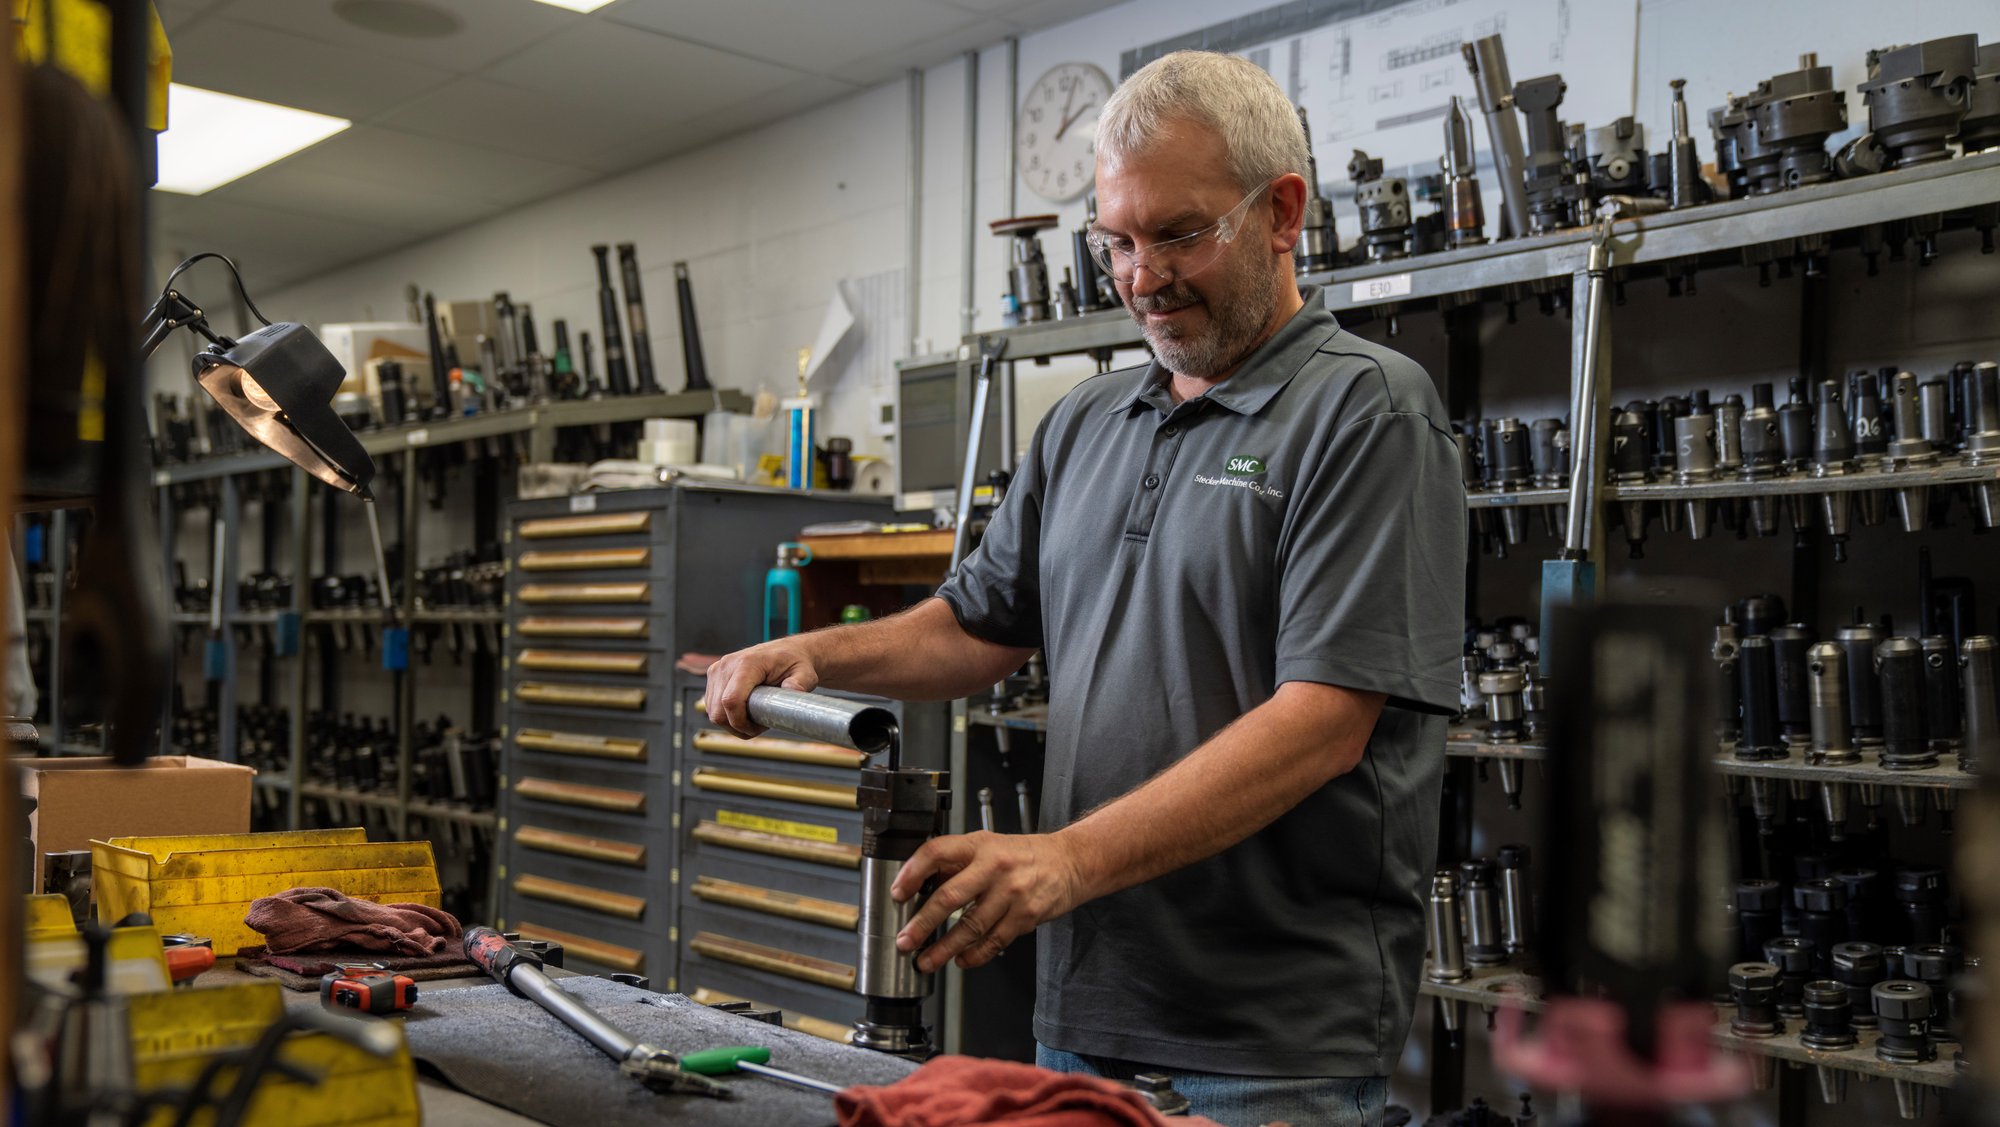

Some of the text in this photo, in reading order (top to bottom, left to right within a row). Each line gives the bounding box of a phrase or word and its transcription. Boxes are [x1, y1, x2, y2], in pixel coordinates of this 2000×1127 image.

[1370, 281, 1392, 297] E30
[1227, 458, 1259, 473] SMC
[1219, 476, 1248, 488] Machine
